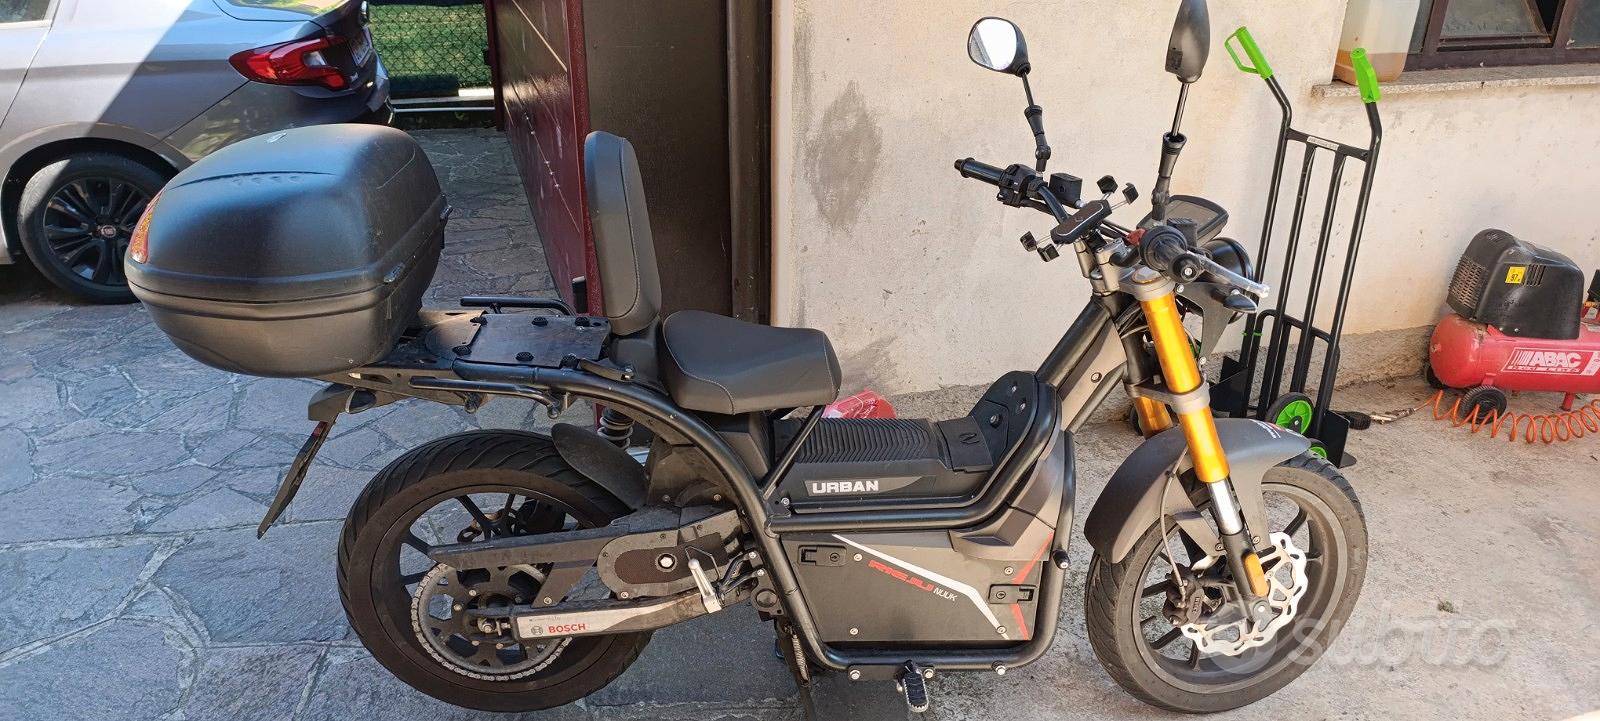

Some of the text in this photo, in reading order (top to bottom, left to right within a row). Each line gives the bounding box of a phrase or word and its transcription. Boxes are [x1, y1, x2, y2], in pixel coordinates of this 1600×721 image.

[1528, 351, 1582, 368] ABAC
[812, 480, 879, 494] URBAN
[933, 587, 958, 601] NUUK
[548, 623, 586, 634] BOSCH
